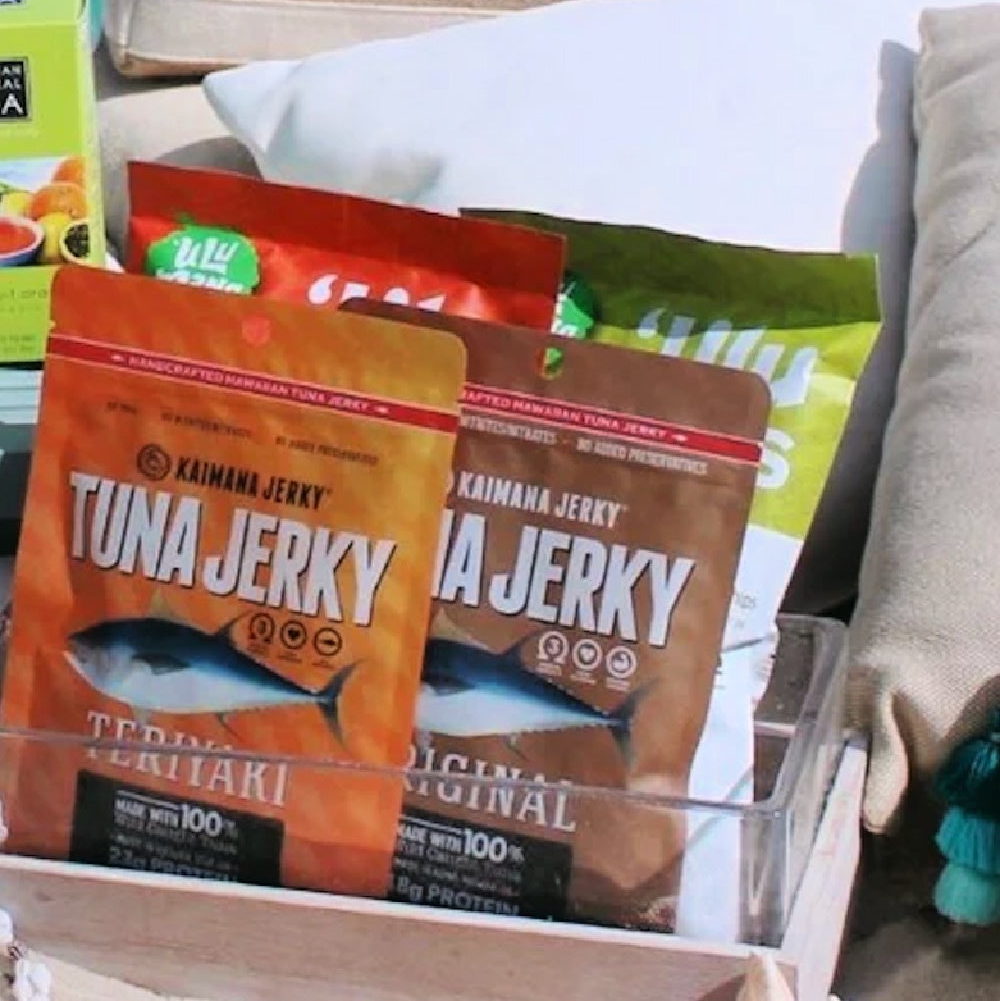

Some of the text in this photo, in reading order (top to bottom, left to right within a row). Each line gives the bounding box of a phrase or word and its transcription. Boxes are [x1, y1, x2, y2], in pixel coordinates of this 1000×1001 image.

[127, 355, 224, 386] HANDCRAFTED
[291, 386, 326, 403] TUNA
[326, 392, 370, 413] JERKY
[512, 397, 582, 423] HAWAIIAN
[582, 411, 620, 431] TUNA
[622, 418, 668, 441] JERKY
[173, 455, 328, 510] KAIMANA JERKY
[456, 469, 622, 529] KAIMANA JERKY
[68, 470, 204, 589] TUNA
[202, 506, 398, 628] JERKY
[488, 524, 698, 650] JERKY
[86, 709, 289, 807] TERIYAKI
[462, 827, 526, 862] 100%
[427, 883, 520, 916] PROTEIN
